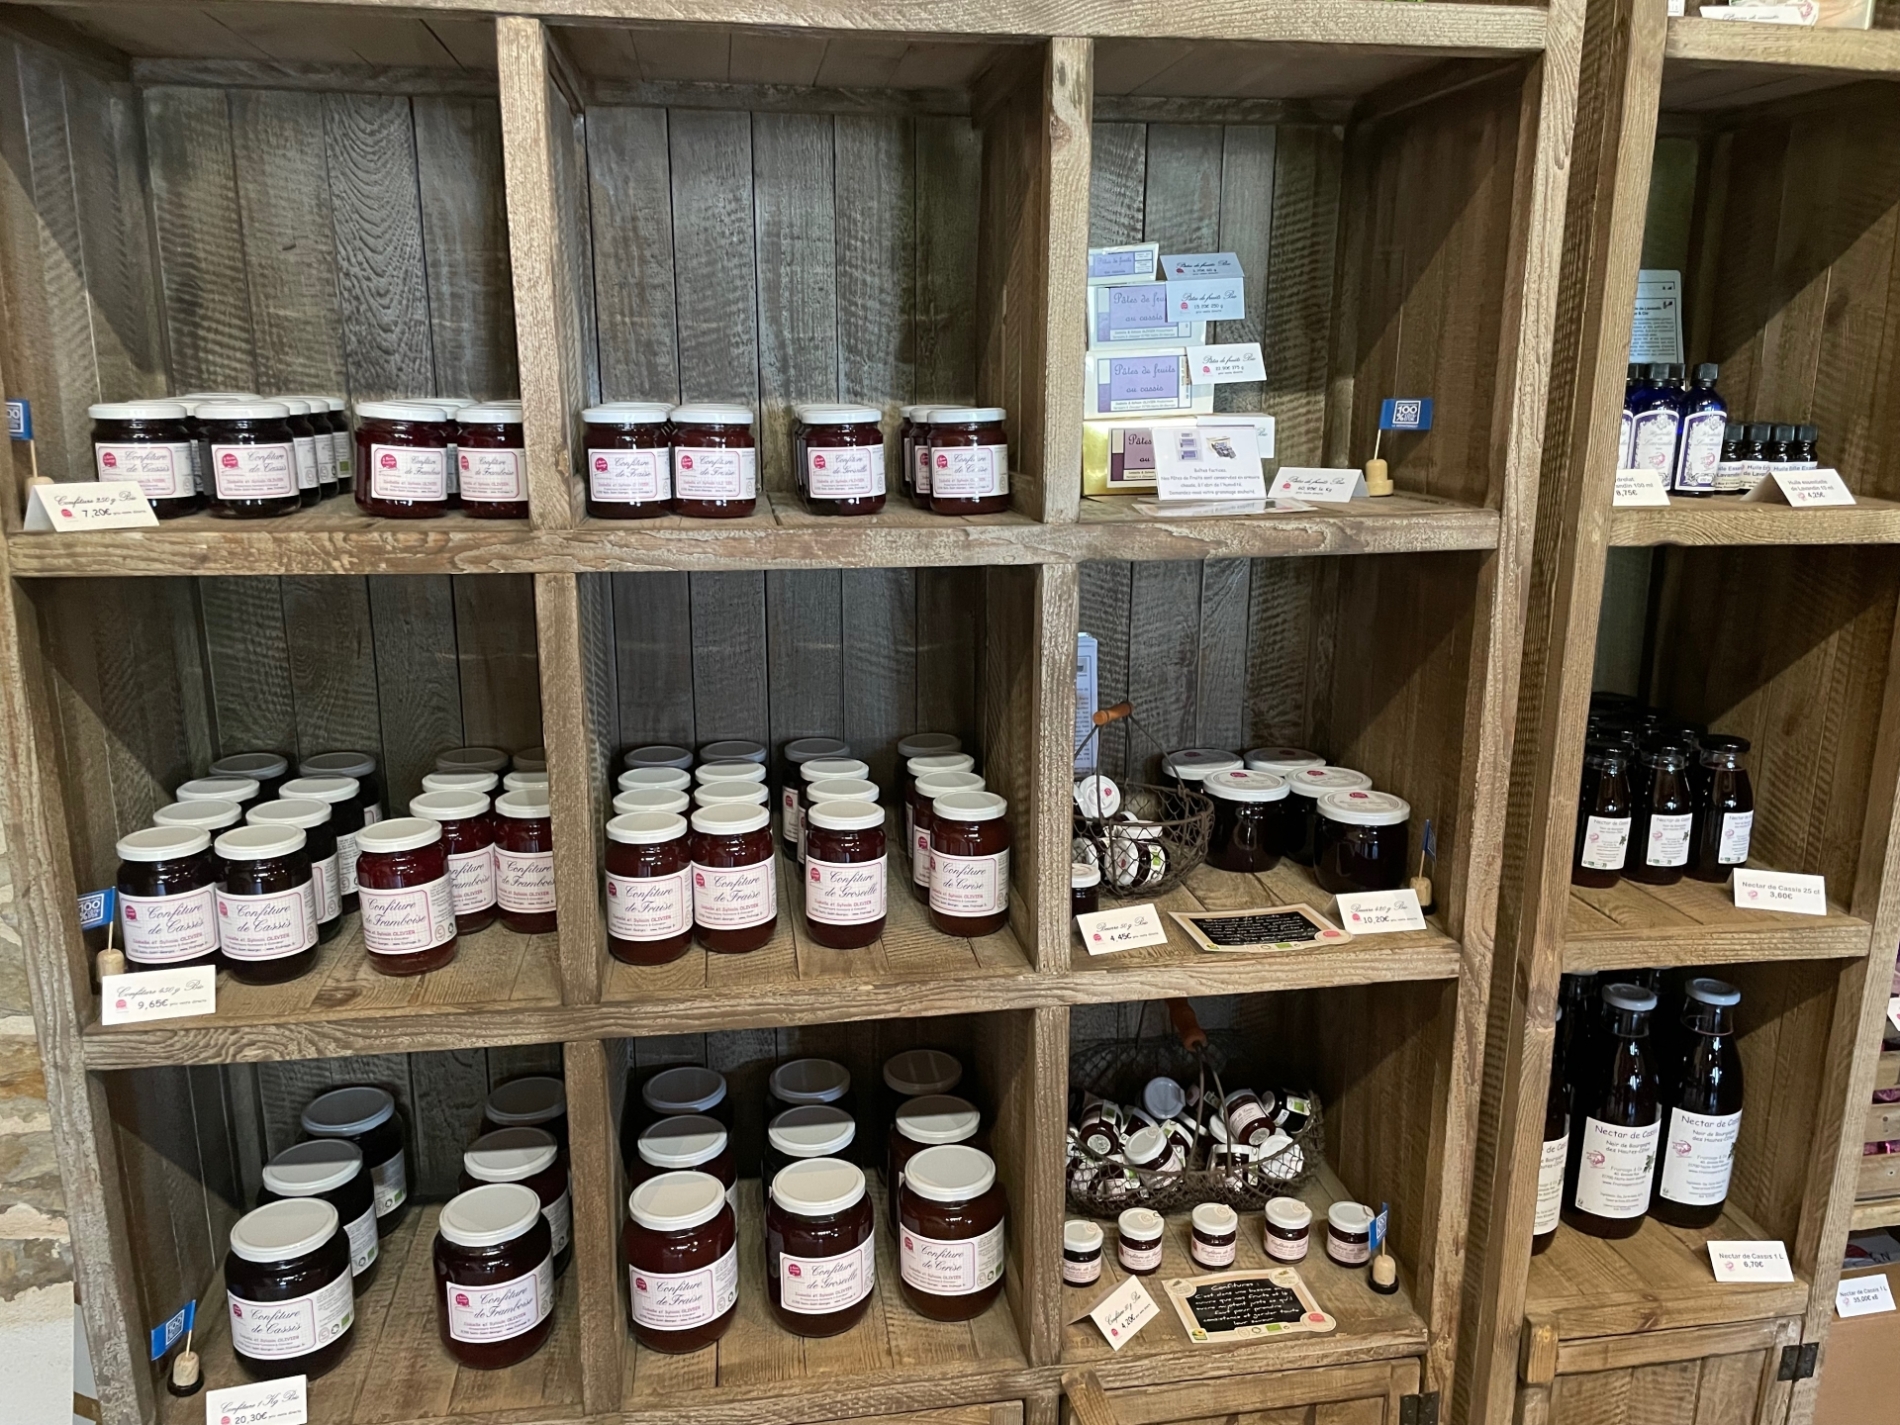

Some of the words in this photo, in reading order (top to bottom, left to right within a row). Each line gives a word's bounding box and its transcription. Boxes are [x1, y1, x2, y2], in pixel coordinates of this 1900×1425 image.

[1113, 292, 1138, 304] Pâtes
[1140, 294, 1150, 303] de
[1139, 314, 1163, 322] cassis
[1114, 363, 1138, 376] Pâtes
[1141, 365, 1151, 373] de
[1153, 363, 1176, 377] fruits
[1140, 385, 1164, 393] cassis
[1397, 405, 1418, 414] 100
[1128, 433, 1152, 445] Pâtes
[124, 451, 168, 463] Confiture
[246, 451, 285, 463] Confiture
[614, 457, 650, 470] Confiture
[54, 496, 94, 508] Confiture
[119, 491, 137, 502] Bio
[82, 508, 112, 518] 7,20€
[450, 862, 485, 878] nfiture
[507, 861, 552, 876] Confiture
[942, 862, 986, 878] Confiture
[714, 874, 761, 892] Confiture
[830, 871, 874, 887] Confiture
[943, 879, 953, 888] de
[956, 878, 984, 890] Cerise
[625, 884, 673, 902] Confiture
[825, 887, 836, 897] de
[839, 882, 878, 898] Groseille
[1742, 881, 1766, 889] Nectar
[1778, 885, 1802, 893] Cassis
[714, 892, 726, 902] de
[726, 890, 761, 903] Fraise
[1770, 891, 1793, 900] 3,60€
[236, 903, 291, 921] Confiture
[368, 897, 416, 915] Confiture
[625, 902, 637, 913] de
[636, 901, 674, 914] Fraise
[147, 903, 203, 923] Confiture
[1363, 915, 1390, 924] 10,20€
[147, 923, 162, 935] de
[166, 917, 204, 934] Cassis
[237, 921, 250, 932] de
[253, 919, 291, 933] Cassis
[366, 915, 373, 924] de
[373, 913, 426, 927] Framboise
[180, 932, 203, 942] OLIVIER
[267, 933, 290, 941] OLIVIER
[116, 986, 157, 1000] Confiture
[184, 979, 204, 992] Bio
[137, 999, 169, 1011] 9,65€
[1681, 1115, 1715, 1128] Nectar
[1717, 1120, 1726, 1128] de
[1595, 1125, 1628, 1138] Nectar
[1630, 1131, 1640, 1139] de
[1546, 1145, 1555, 1154] de
[921, 1244, 964, 1260] Confiture
[811, 1262, 855, 1278] Confiture
[922, 1260, 933, 1269] de
[934, 1260, 963, 1272] Cerise
[1743, 1261, 1764, 1269] 6,70€
[807, 1279, 819, 1289] de
[821, 1267, 858, 1289] Groseille
[656, 1280, 703, 1295] Confiture
[1211, 1282, 1254, 1291] Confitures
[480, 1287, 528, 1306] Confiture
[656, 1296, 668, 1306] de
[668, 1294, 703, 1306] Fraise
[474, 1308, 485, 1319] de
[486, 1298, 534, 1318] Framboise
[250, 1308, 300, 1326] Confiture
[251, 1324, 262, 1334] de
[266, 1322, 302, 1335] Cassis
[220, 1401, 255, 1415] Confiture
[282, 1389, 299, 1403] Bio
[235, 1412, 268, 1425] 20,30€
